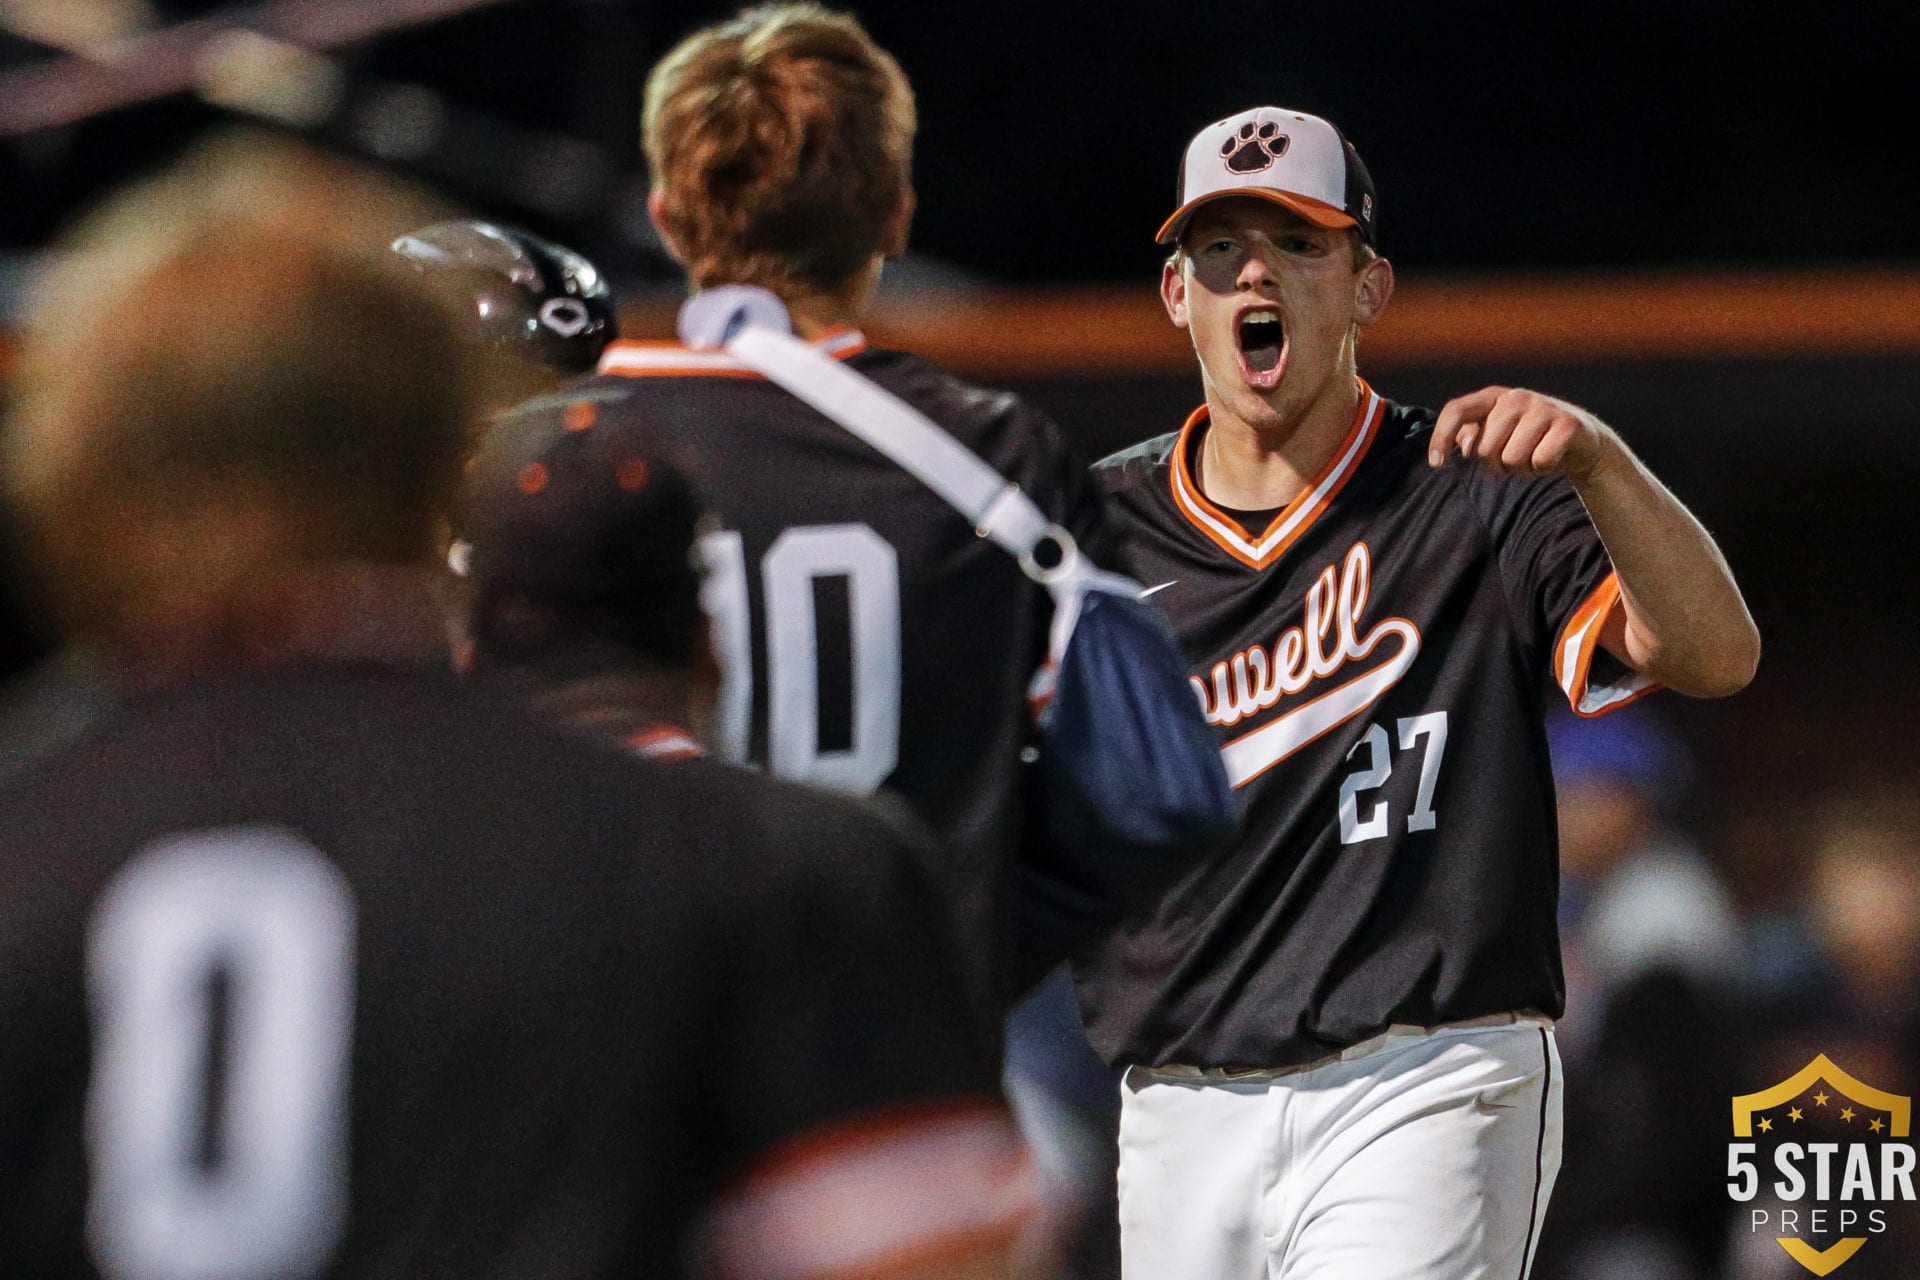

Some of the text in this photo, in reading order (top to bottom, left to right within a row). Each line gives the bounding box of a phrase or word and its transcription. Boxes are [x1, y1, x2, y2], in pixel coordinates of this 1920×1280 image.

[697, 521, 901, 796] 10
[1189, 541, 1421, 726] well
[1338, 711, 1448, 844] 27
